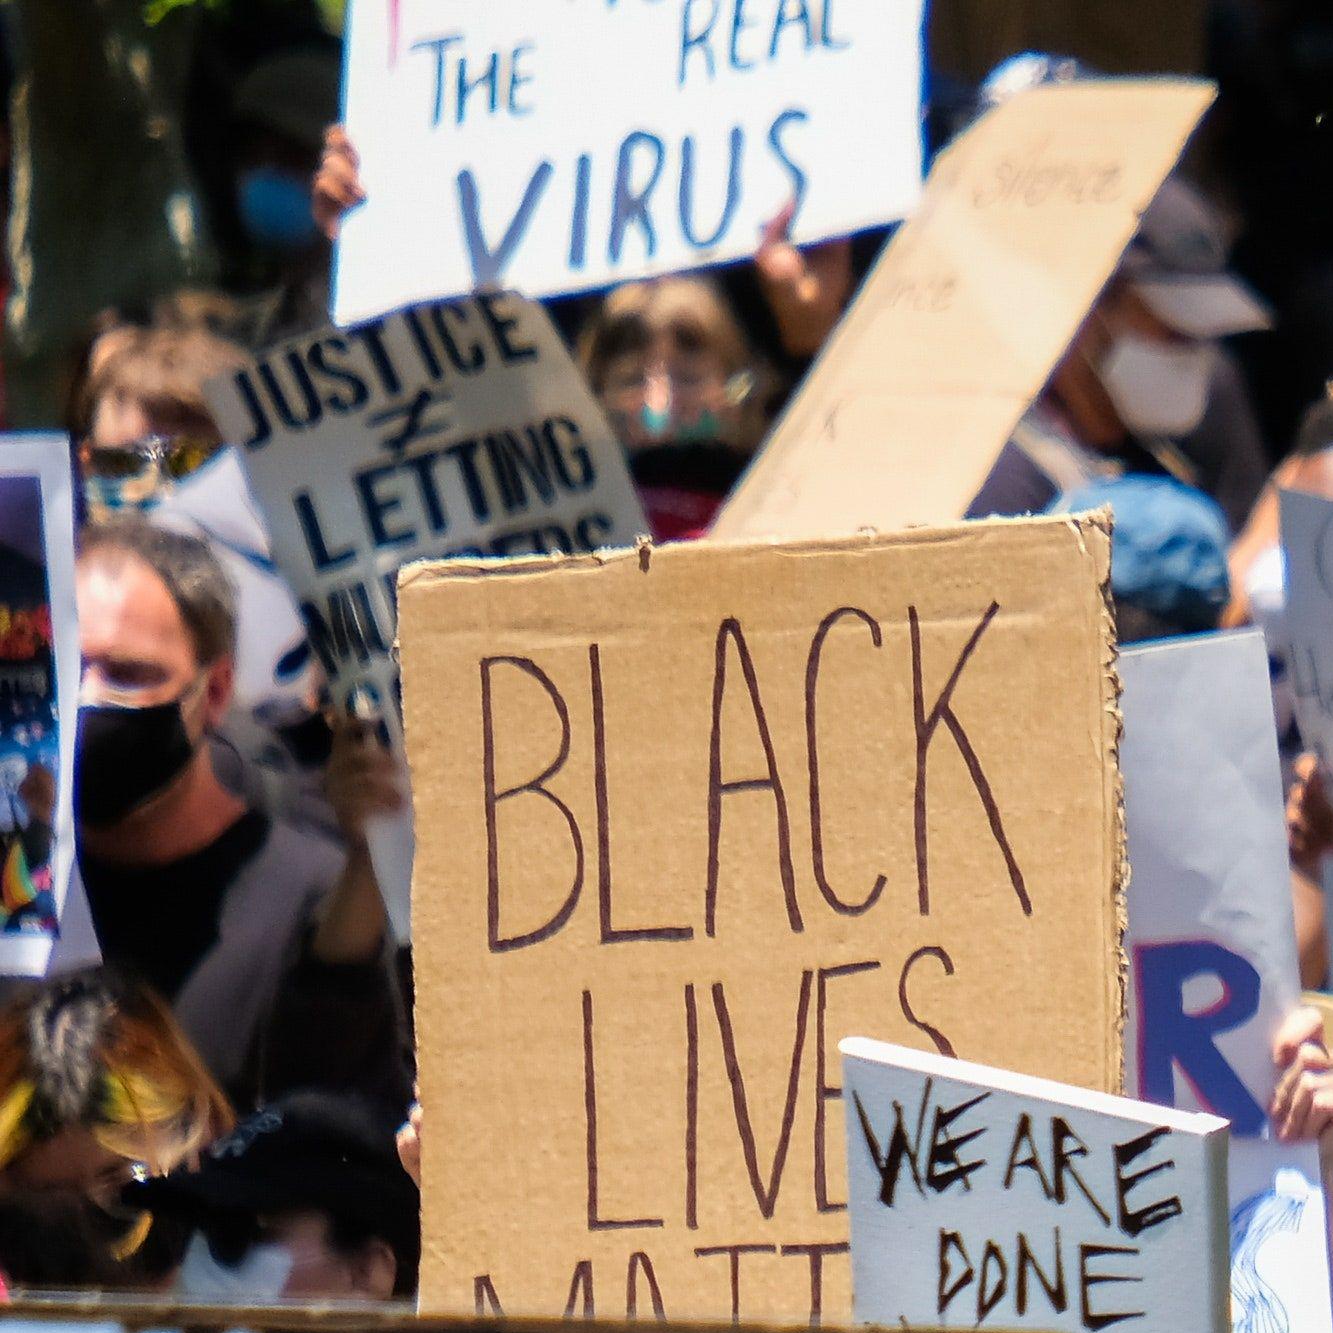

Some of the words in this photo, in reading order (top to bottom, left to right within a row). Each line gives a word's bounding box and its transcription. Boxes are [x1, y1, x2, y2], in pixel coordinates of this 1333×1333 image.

[411, 34, 535, 127] THE
[676, 0, 852, 84] REAL
[456, 108, 810, 292] VIRUS
[232, 288, 540, 450] JUSTICE
[290, 414, 598, 572] LETTING
[480, 598, 1032, 952] BLACK
[852, 1076, 993, 1208] WE
[1003, 1111, 1183, 1237] ARE
